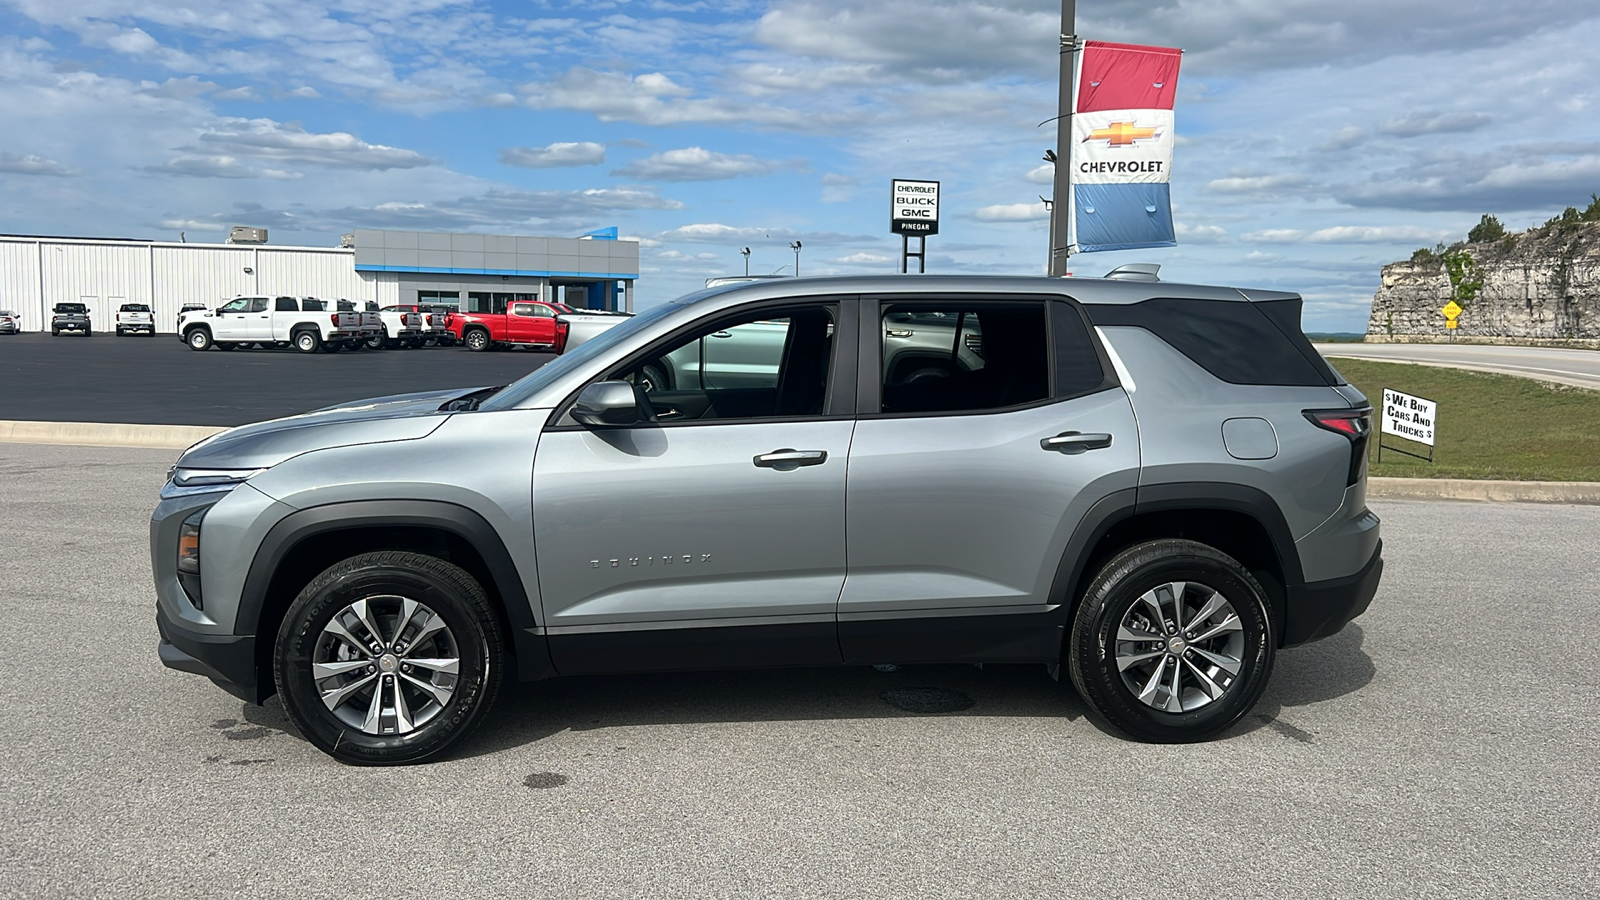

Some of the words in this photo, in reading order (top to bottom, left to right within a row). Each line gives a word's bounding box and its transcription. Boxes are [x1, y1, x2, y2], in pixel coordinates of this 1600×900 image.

[1080, 161, 1163, 173] CHEVROLET
[897, 185, 935, 193] CHEVROLET
[896, 197, 935, 205] BUICK
[901, 209, 930, 217] GMC
[1392, 394, 1407, 407] WE
[1410, 399, 1427, 413] BUY
[1387, 406, 1410, 421] CARS
[1412, 413, 1430, 427] AND
[1392, 420, 1423, 438] TRUCKS
[590, 553, 712, 568] EQUINOX
